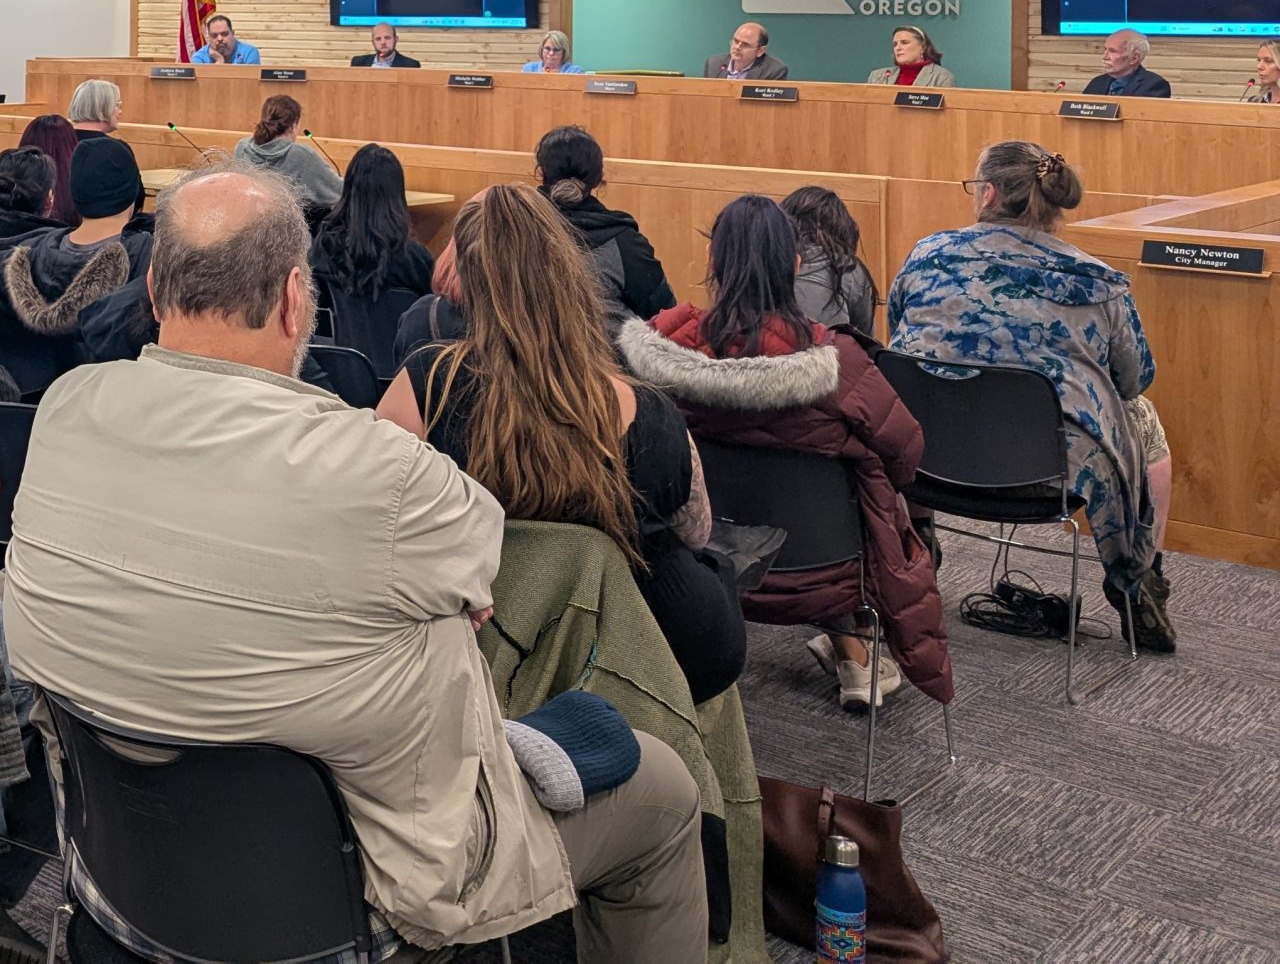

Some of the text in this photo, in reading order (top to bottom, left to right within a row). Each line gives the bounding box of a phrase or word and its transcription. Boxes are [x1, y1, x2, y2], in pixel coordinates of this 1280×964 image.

[1165, 246, 1239, 259] Nancy Newton
[1175, 256, 1228, 267] City Manager
